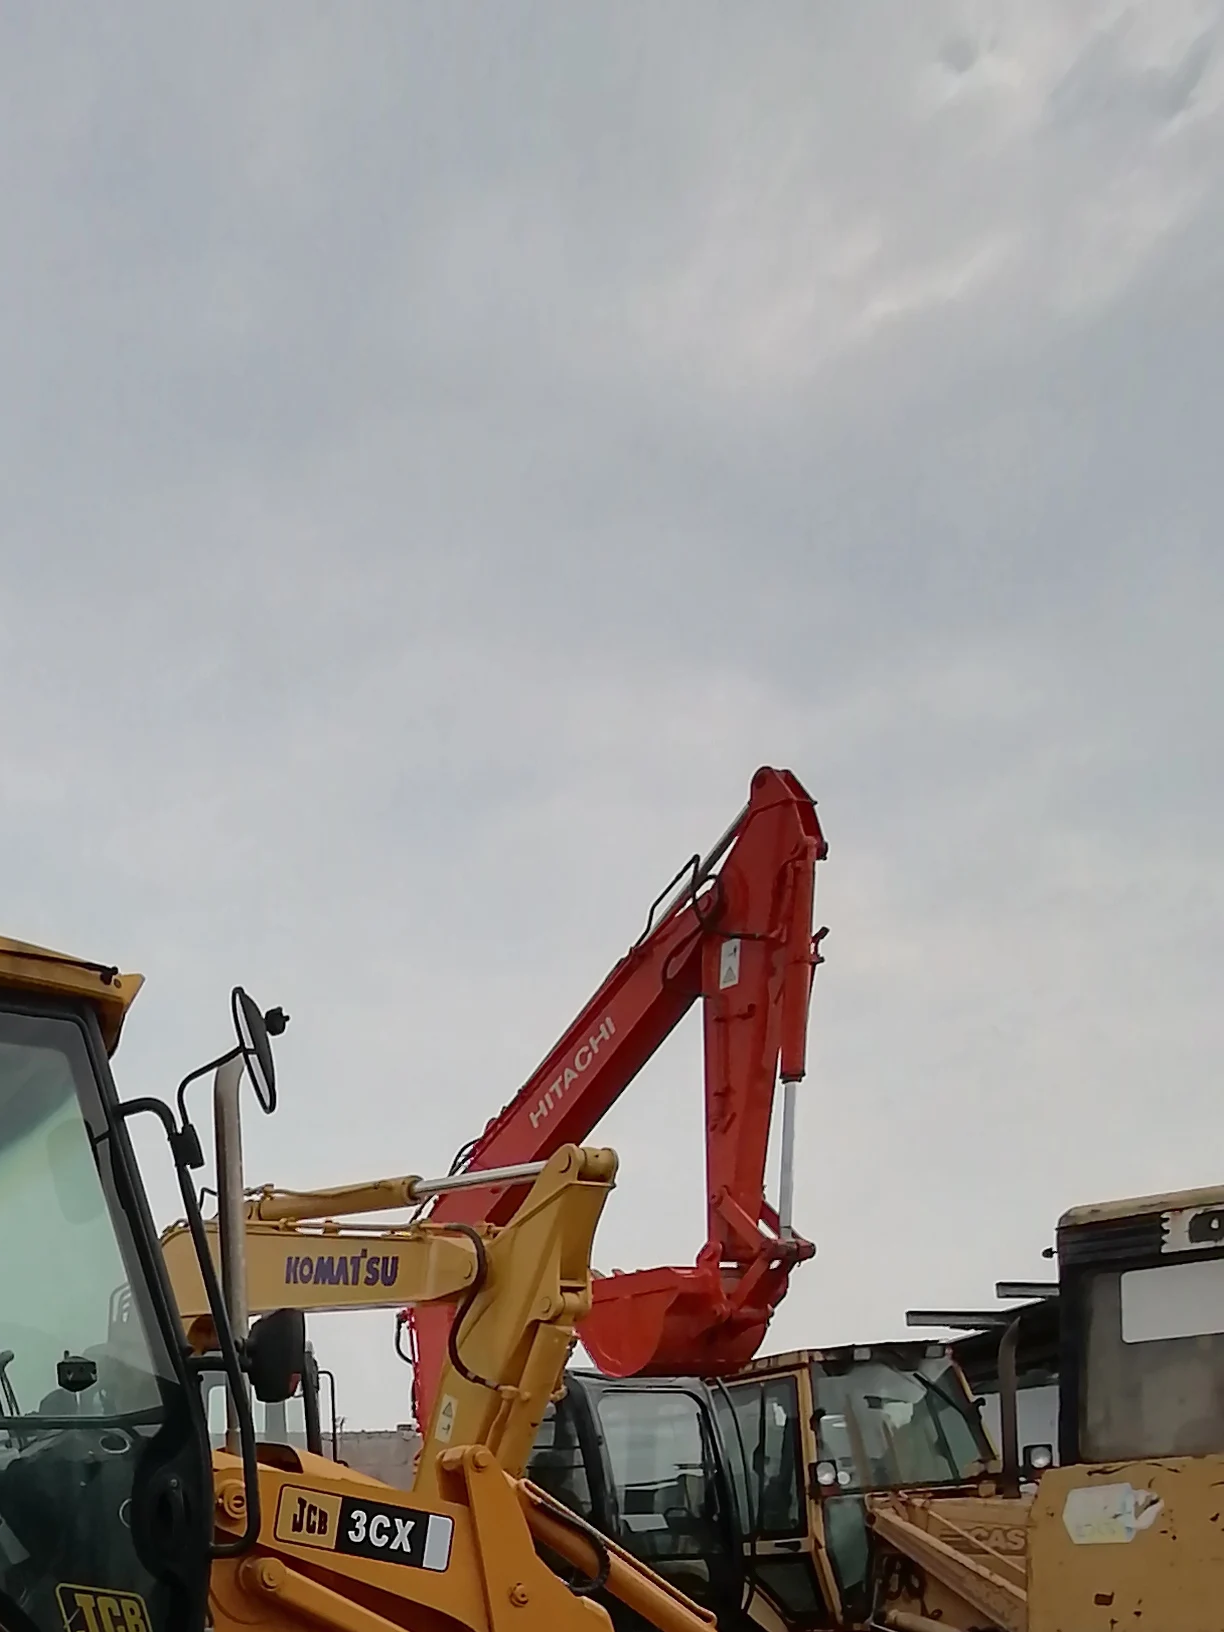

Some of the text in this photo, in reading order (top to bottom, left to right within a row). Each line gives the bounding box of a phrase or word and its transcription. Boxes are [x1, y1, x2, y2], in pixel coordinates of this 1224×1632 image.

[529, 1016, 616, 1129] HITACHI
[285, 1248, 399, 1287] KOMATSU
[291, 1496, 416, 1553] JCB 3CX
[968, 1526, 1027, 1552] CAS
